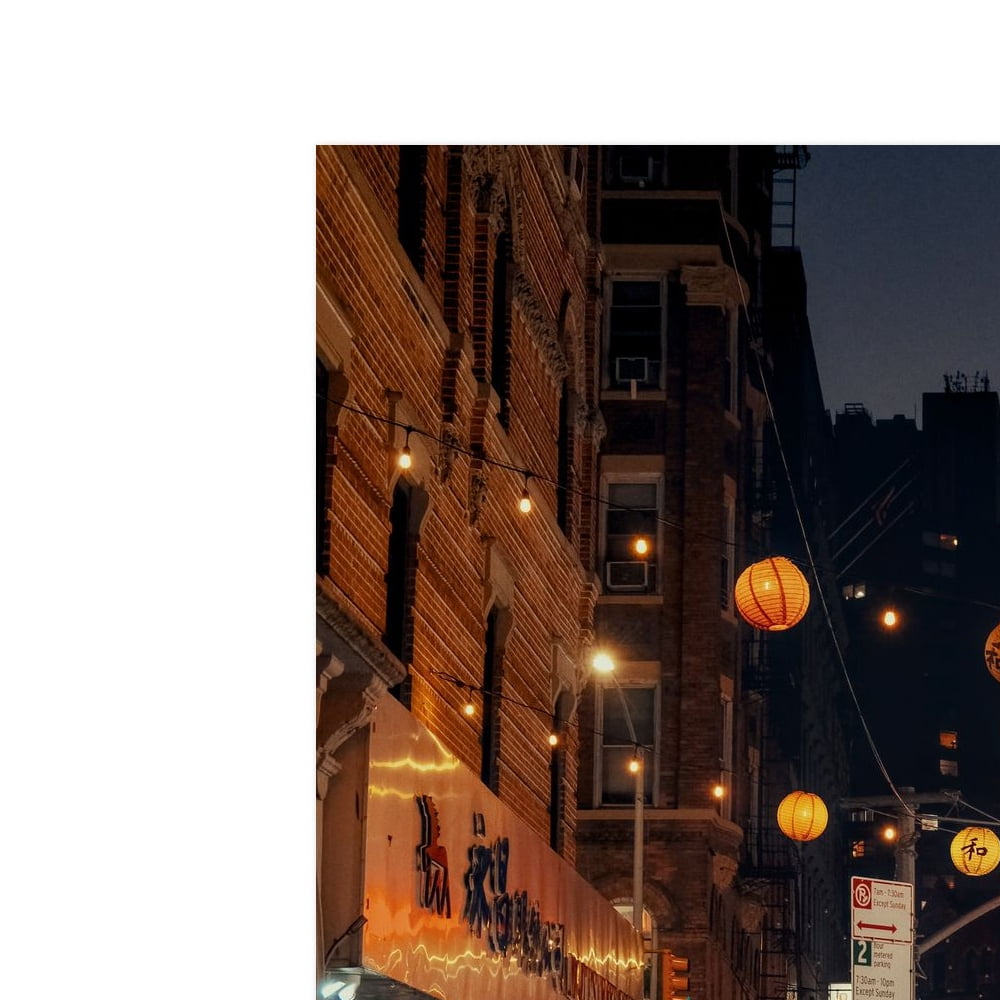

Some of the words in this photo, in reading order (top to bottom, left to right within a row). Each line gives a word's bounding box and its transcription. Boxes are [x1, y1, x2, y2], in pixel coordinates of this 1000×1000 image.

[961, 838, 988, 861] 和
[874, 899, 889, 908] Except
[890, 901, 906, 911] Sunday
[858, 941, 868, 964] 2
[874, 952, 893, 960] metered
[874, 961, 891, 969] parking
[856, 976, 877, 985] 7:30am
[881, 977, 895, 987] 10pm
[856, 986, 875, 997] Except
[876, 988, 896, 1000] Sunday
